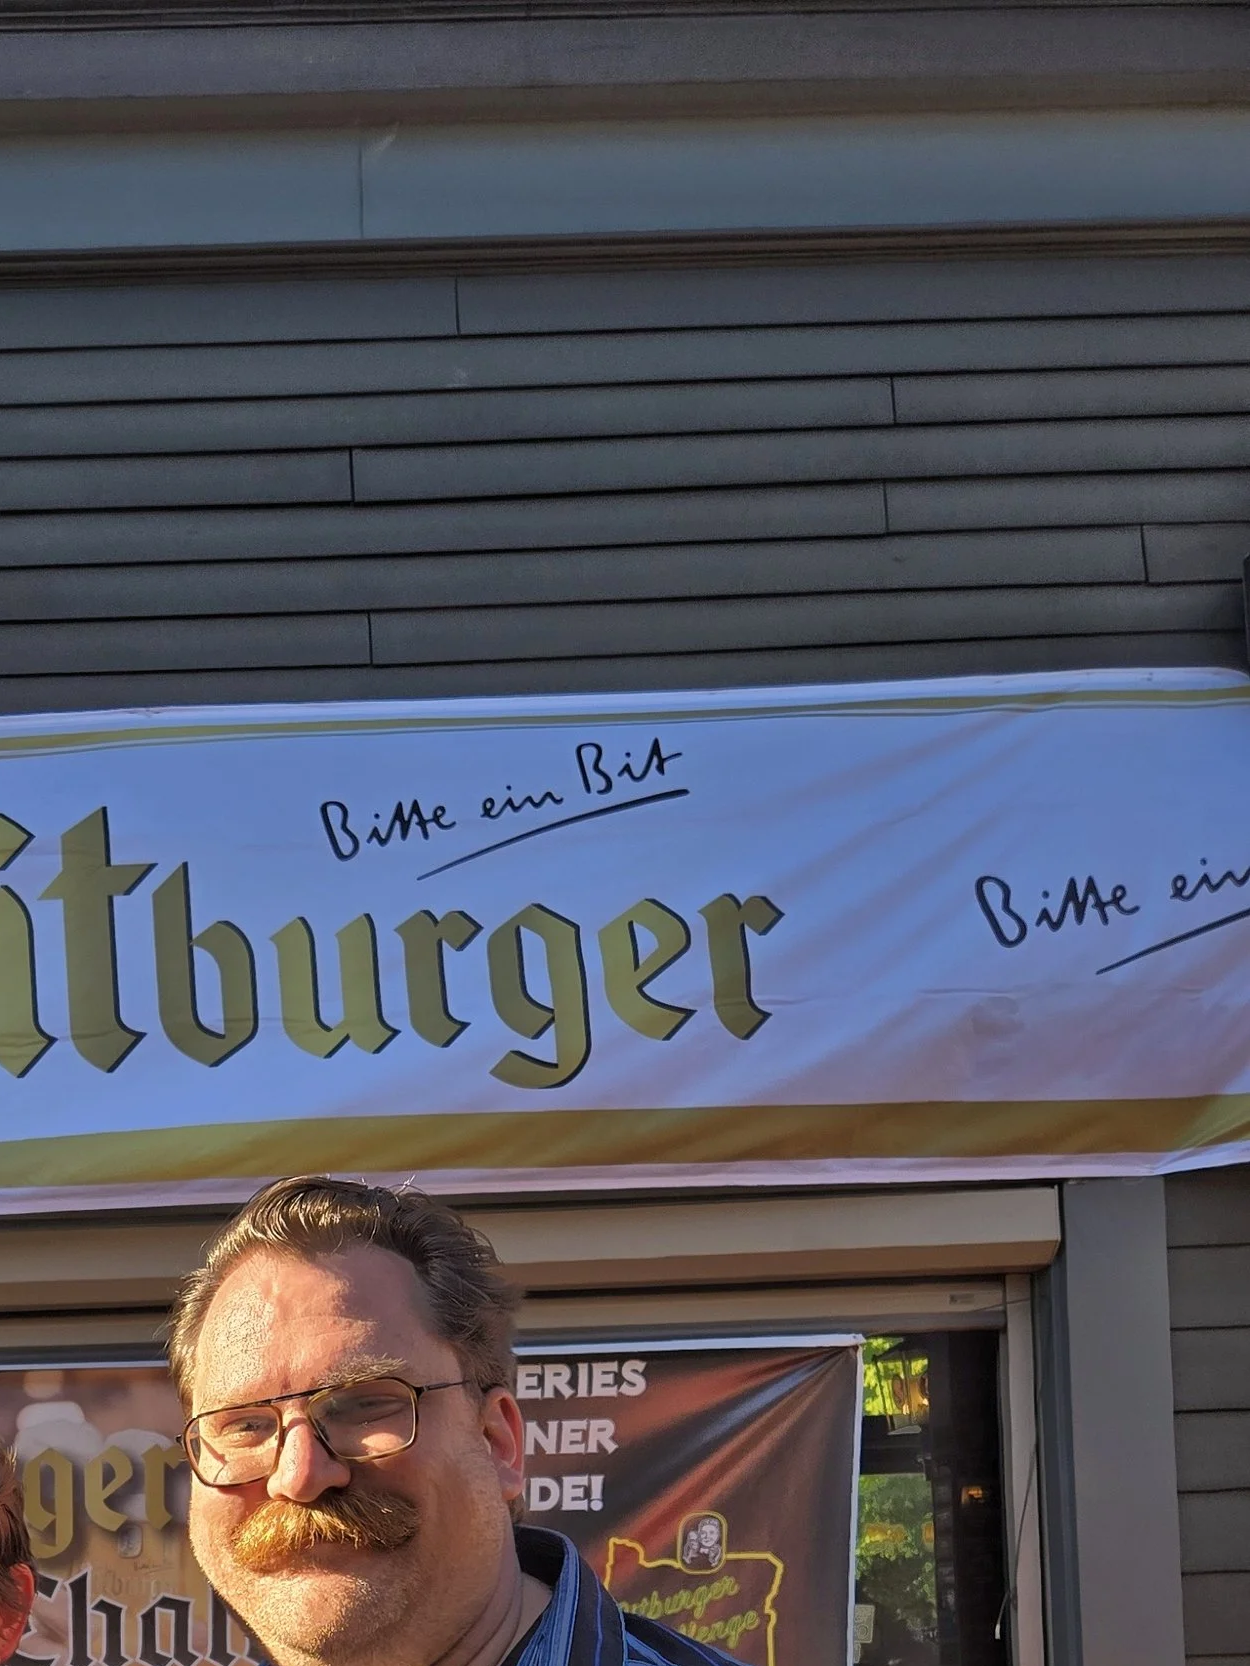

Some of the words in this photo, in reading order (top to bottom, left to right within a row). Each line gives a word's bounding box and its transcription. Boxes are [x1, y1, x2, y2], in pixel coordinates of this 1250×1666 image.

[320, 800, 457, 862] Bitte
[480, 784, 565, 821] ein
[575, 737, 683, 796] Bit
[974, 875, 1140, 949] Bitte
